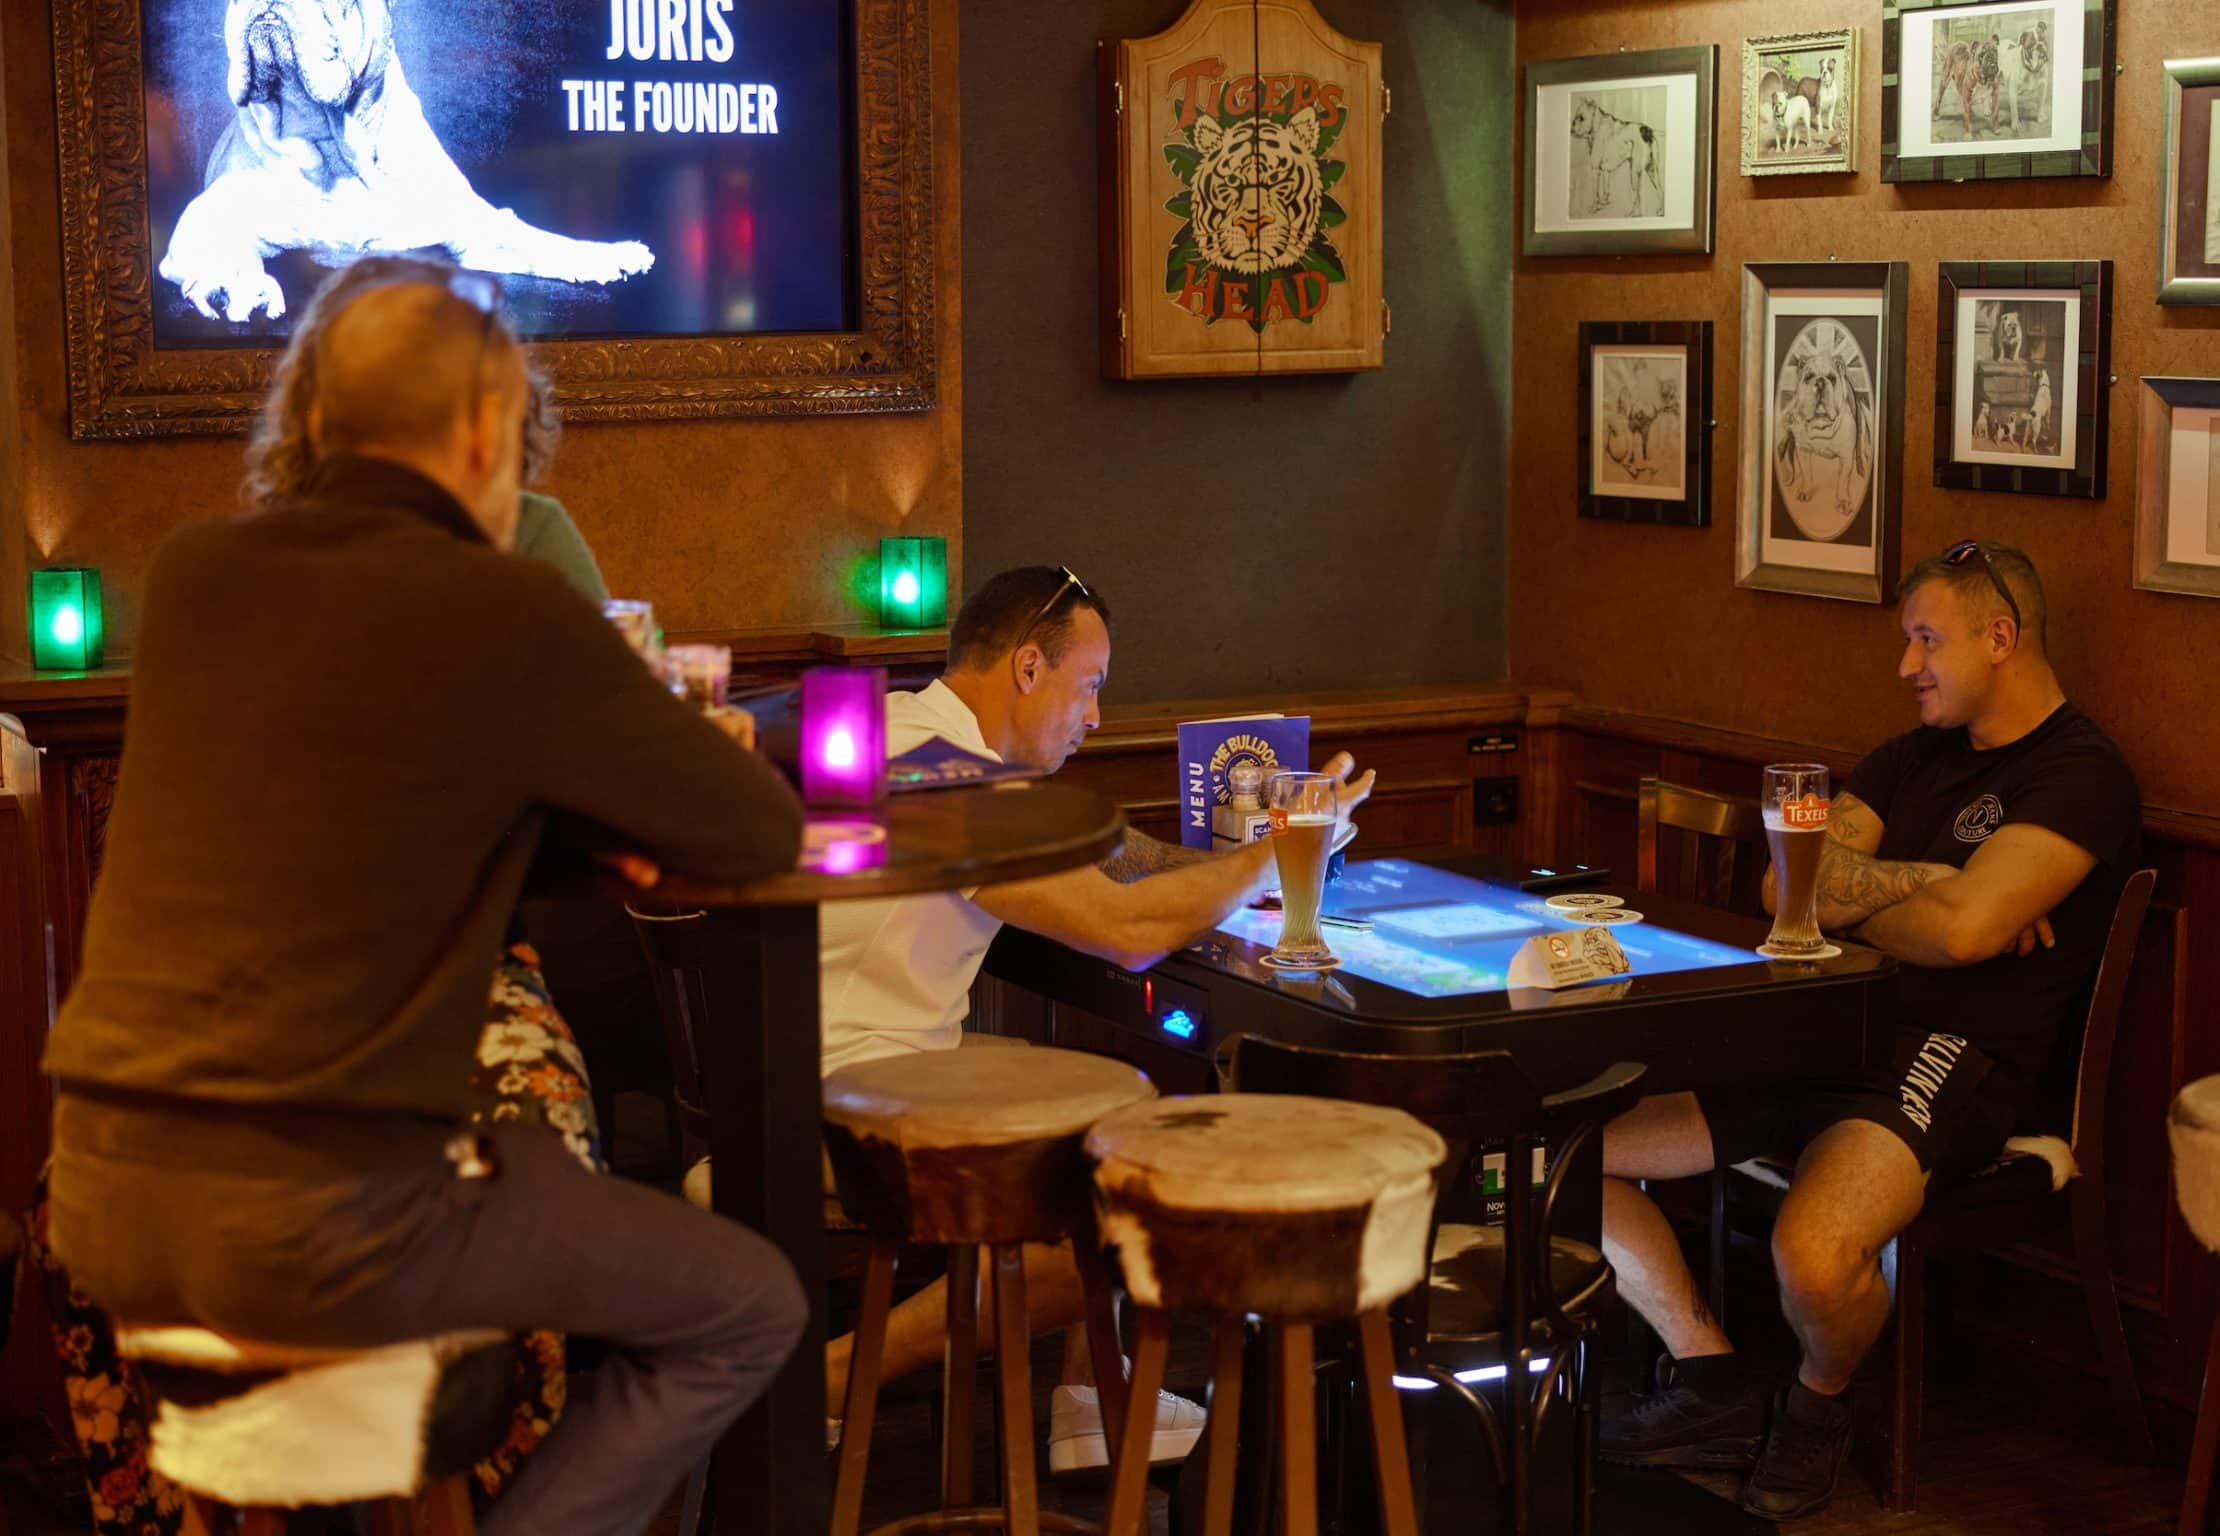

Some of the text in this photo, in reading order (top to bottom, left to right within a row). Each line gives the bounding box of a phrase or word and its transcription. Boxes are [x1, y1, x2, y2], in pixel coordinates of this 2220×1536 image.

[606, 0, 735, 63] JORIS
[562, 80, 779, 134] THE FOUNDER
[1175, 262, 1329, 322] HEAD
[1209, 743, 1231, 773] THE
[1188, 762, 1206, 828] MENU
[1786, 805, 1829, 823] TEXELS
